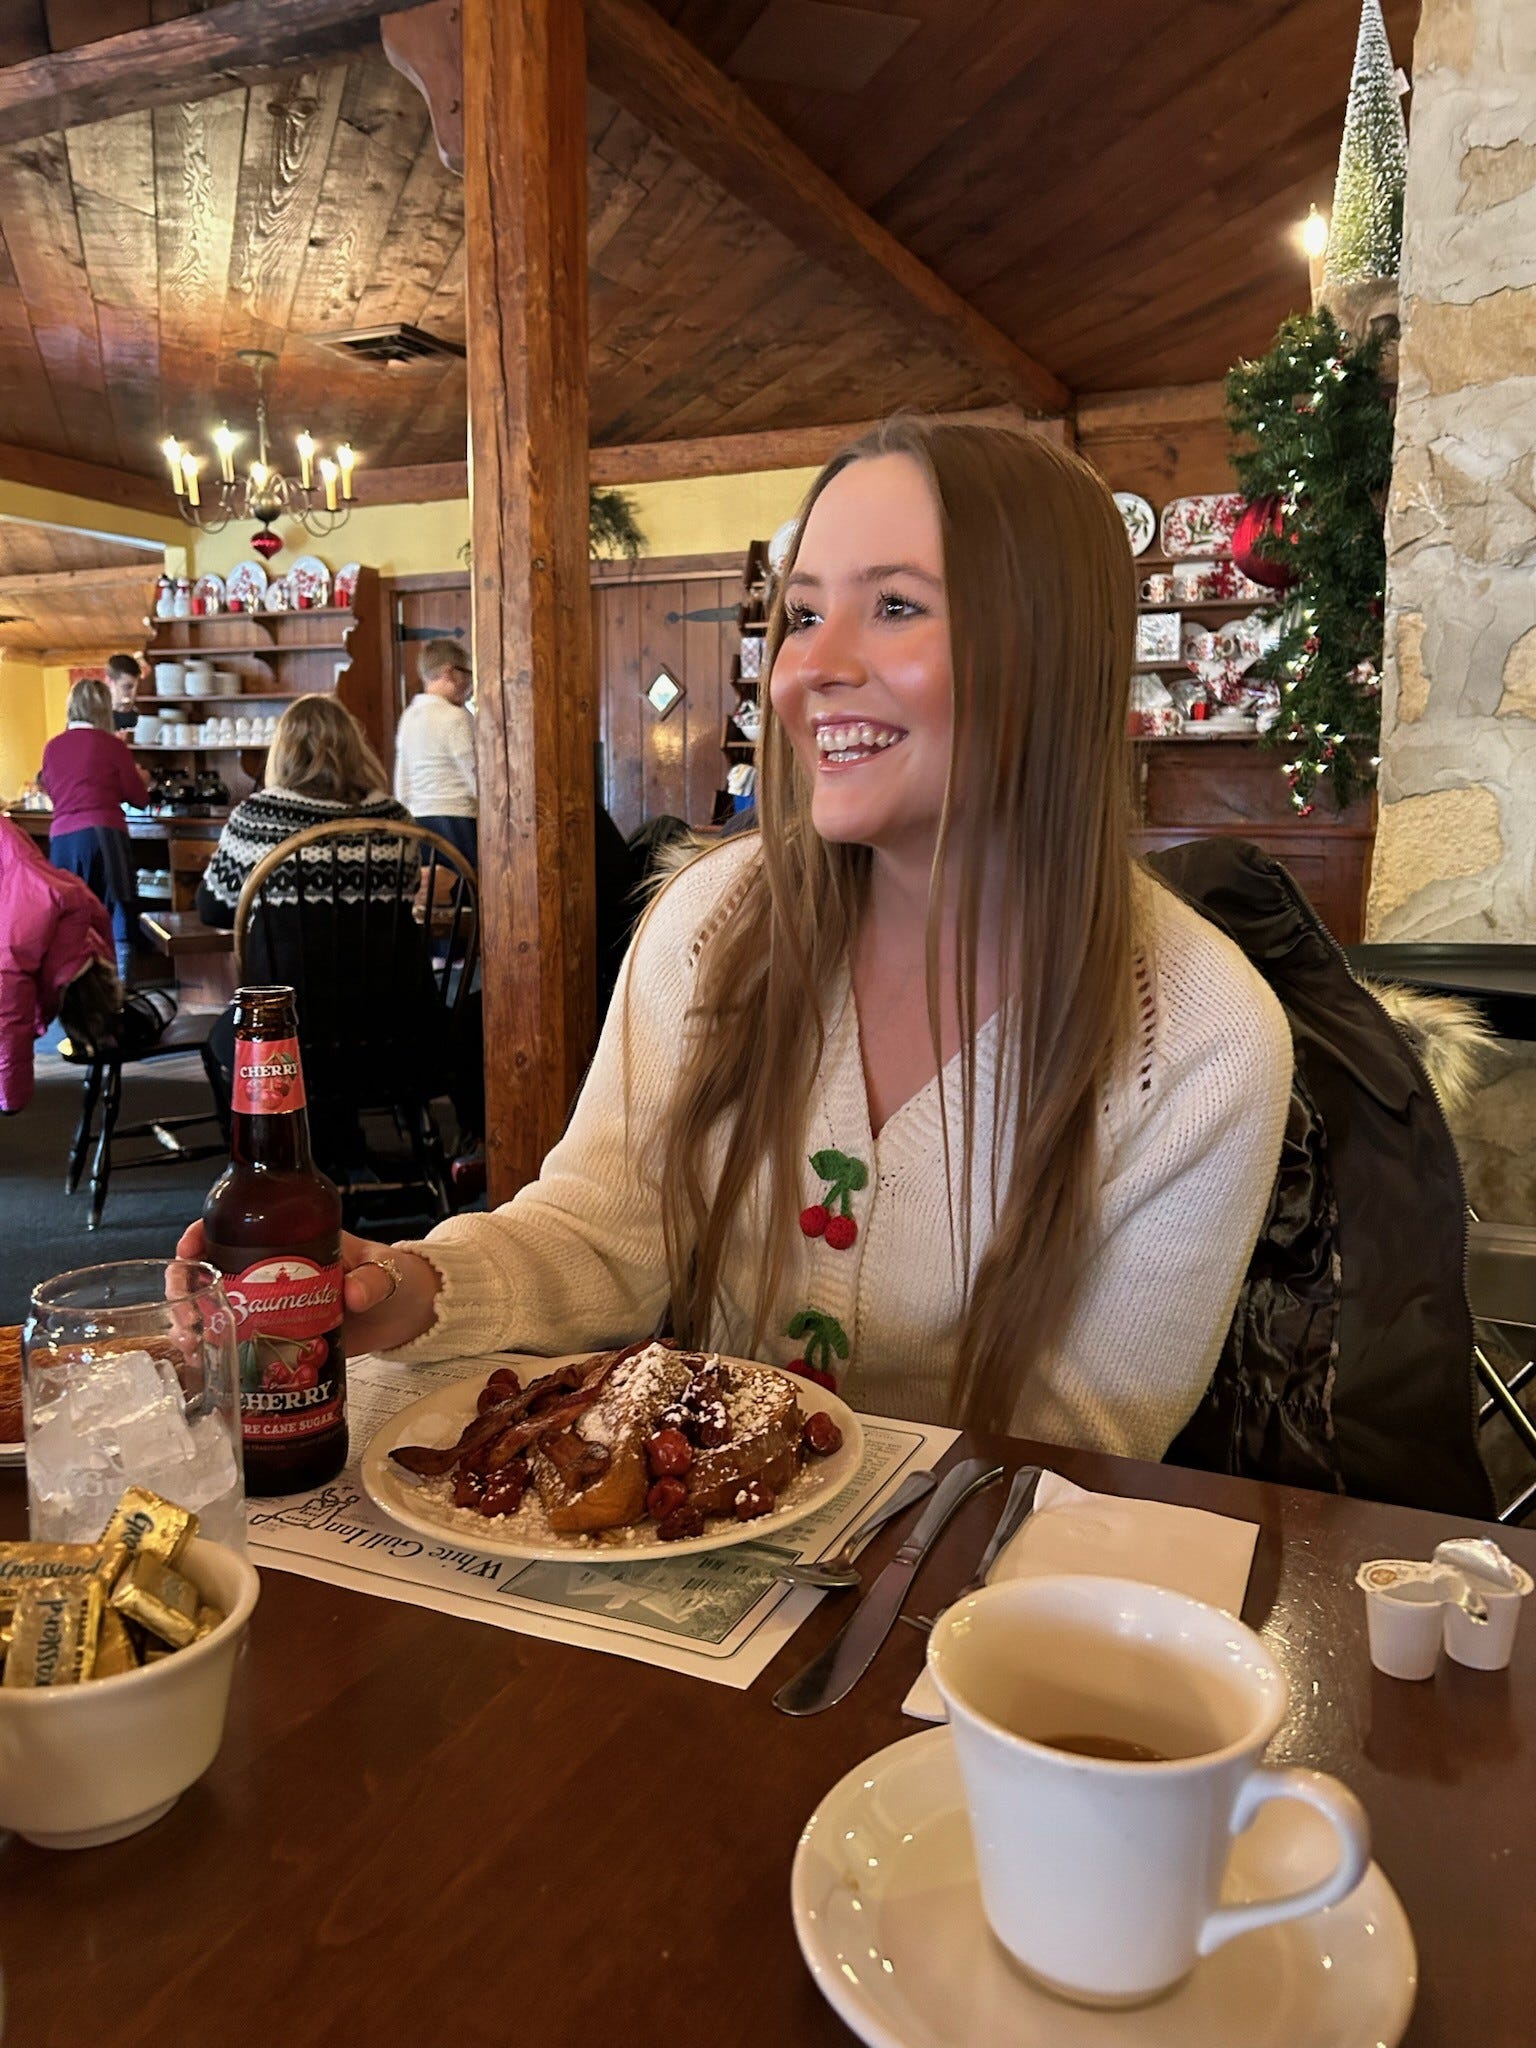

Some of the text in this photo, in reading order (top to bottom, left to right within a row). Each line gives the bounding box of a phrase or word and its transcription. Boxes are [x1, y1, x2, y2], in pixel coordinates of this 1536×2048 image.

[263, 1422, 297, 1435] CANE
[299, 1412, 335, 1431] SUGAR
[0, 1556, 104, 1580] Grassland
[325, 1519, 503, 1580] White Gull Inn
[34, 1599, 68, 1687] rassland
